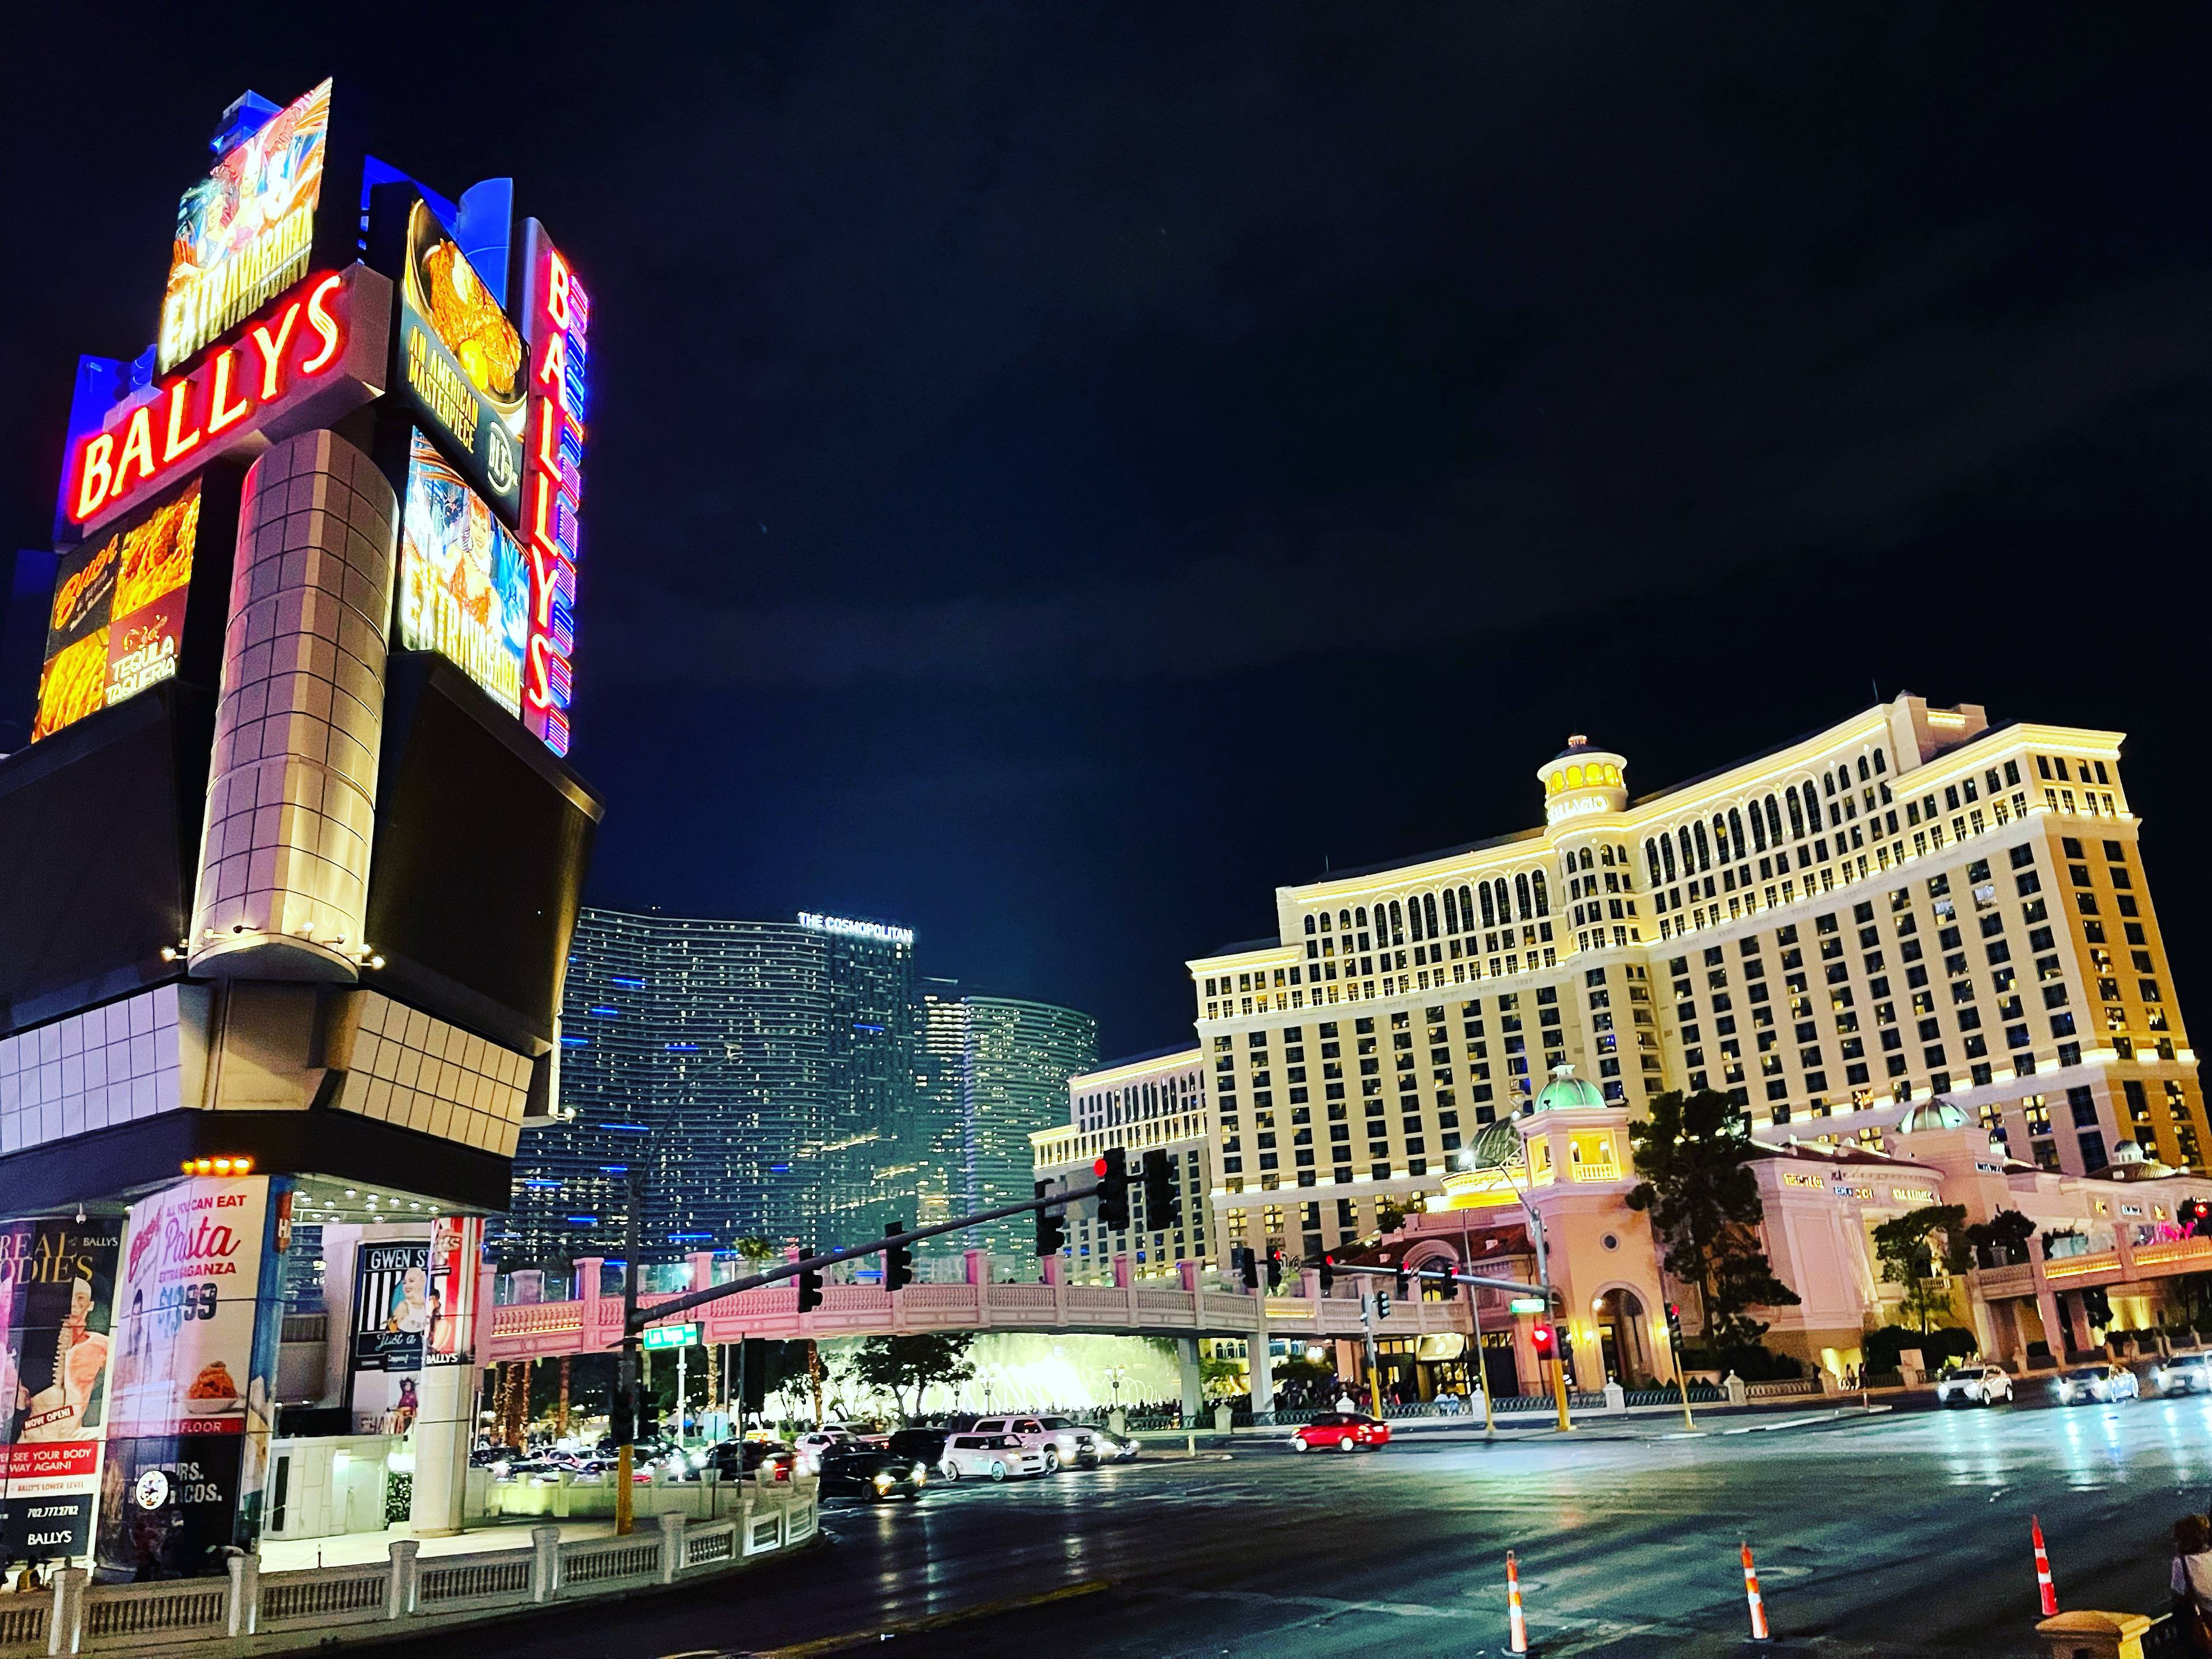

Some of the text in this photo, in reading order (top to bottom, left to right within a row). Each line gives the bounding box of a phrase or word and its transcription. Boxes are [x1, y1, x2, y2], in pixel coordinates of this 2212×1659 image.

[408, 325, 480, 427] AN AMERICAN
[408, 354, 477, 454] MASTERPIECE
[112, 635, 174, 683] TEQUILA
[105, 660, 176, 706] TAQUERIA
[798, 911, 914, 942] THE COSMOPOLITAN
[192, 1197, 213, 1211] CAN
[217, 1195, 247, 1208] EAT
[162, 1215, 241, 1266] Pasta
[0, 1255, 93, 1285] ODIES
[371, 1249, 411, 1270] GWEN
[375, 1334, 416, 1352] Just a
[25, 1415, 45, 1430] NOW
[181, 1421, 222, 1434] FLOOR
[13, 1452, 29, 1462] SEE
[33, 1450, 60, 1460] YOUR
[63, 1448, 92, 1460] BODY
[9, 1463, 31, 1473] WAY
[42, 1483, 64, 1491] LOWER
